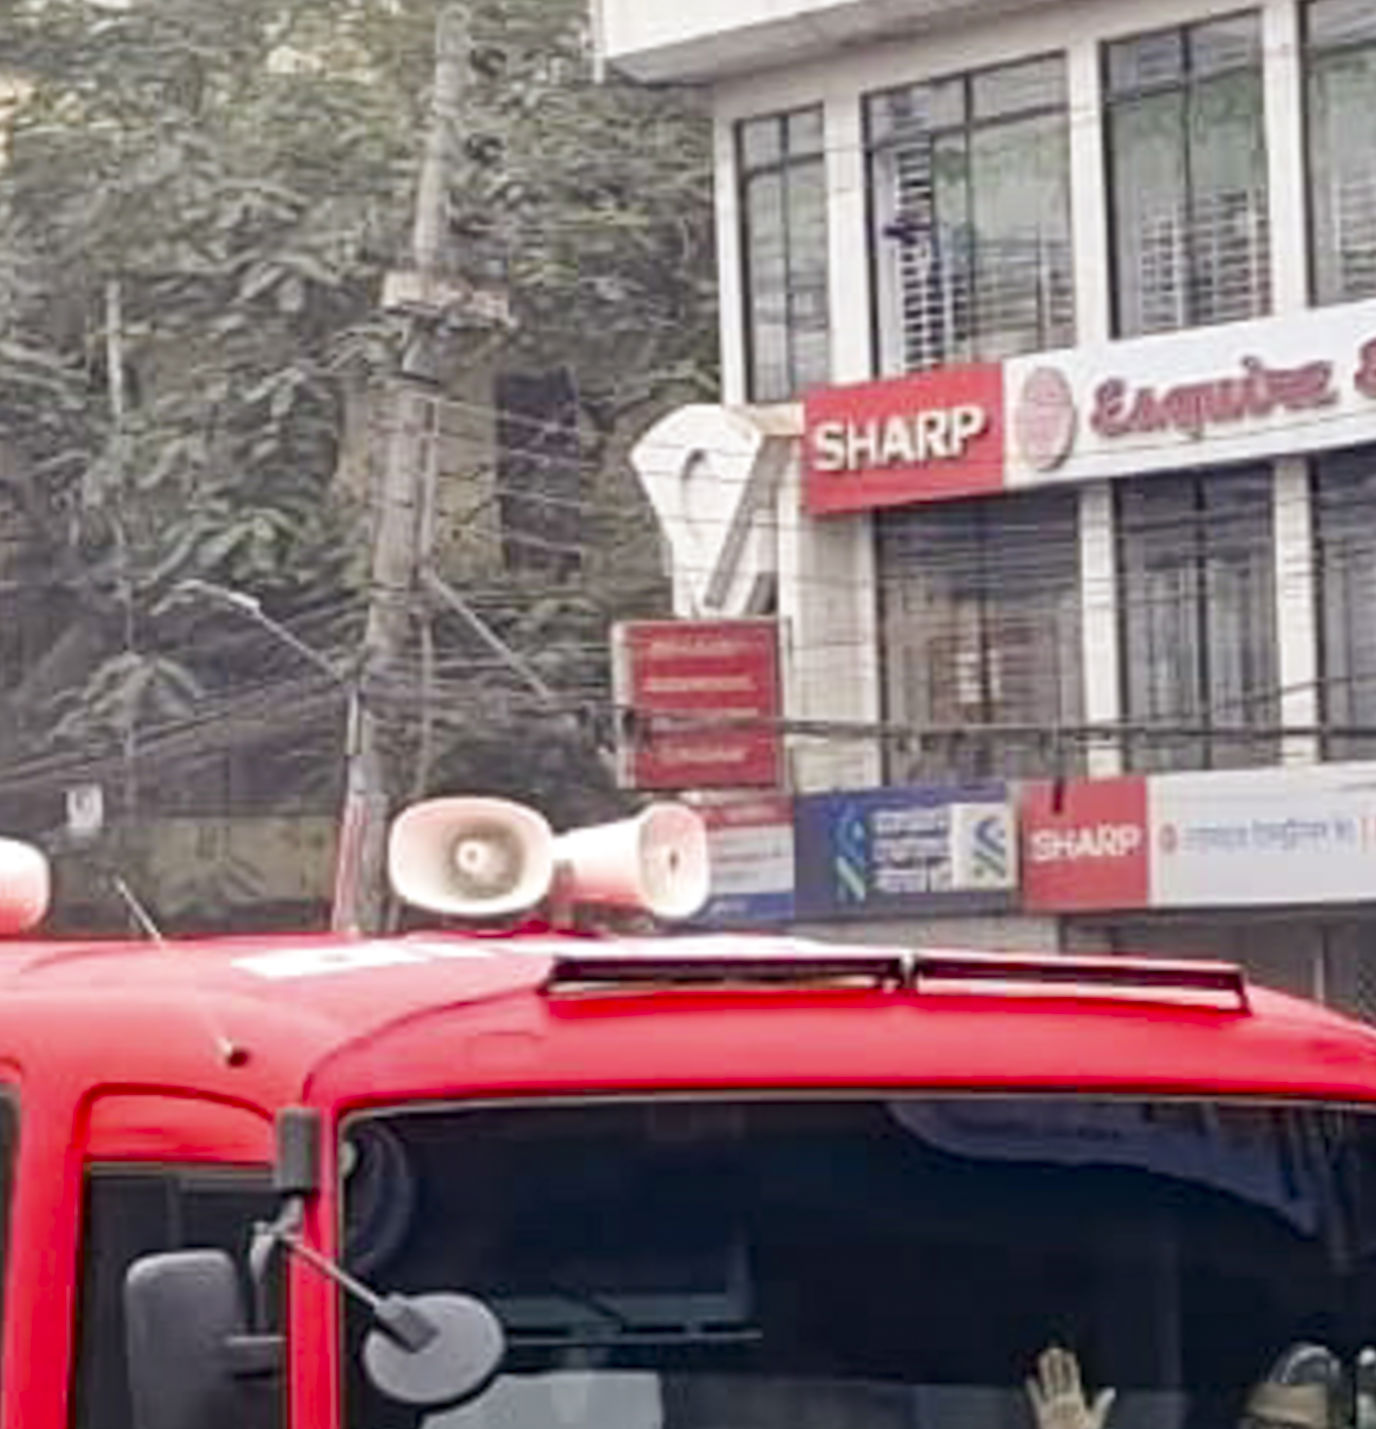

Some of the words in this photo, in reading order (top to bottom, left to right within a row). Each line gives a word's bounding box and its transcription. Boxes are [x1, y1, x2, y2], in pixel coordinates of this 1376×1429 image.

[1090, 355, 1340, 442] Esquire
[812, 403, 987, 472] SHARP
[1030, 823, 1143, 862] SHARP
